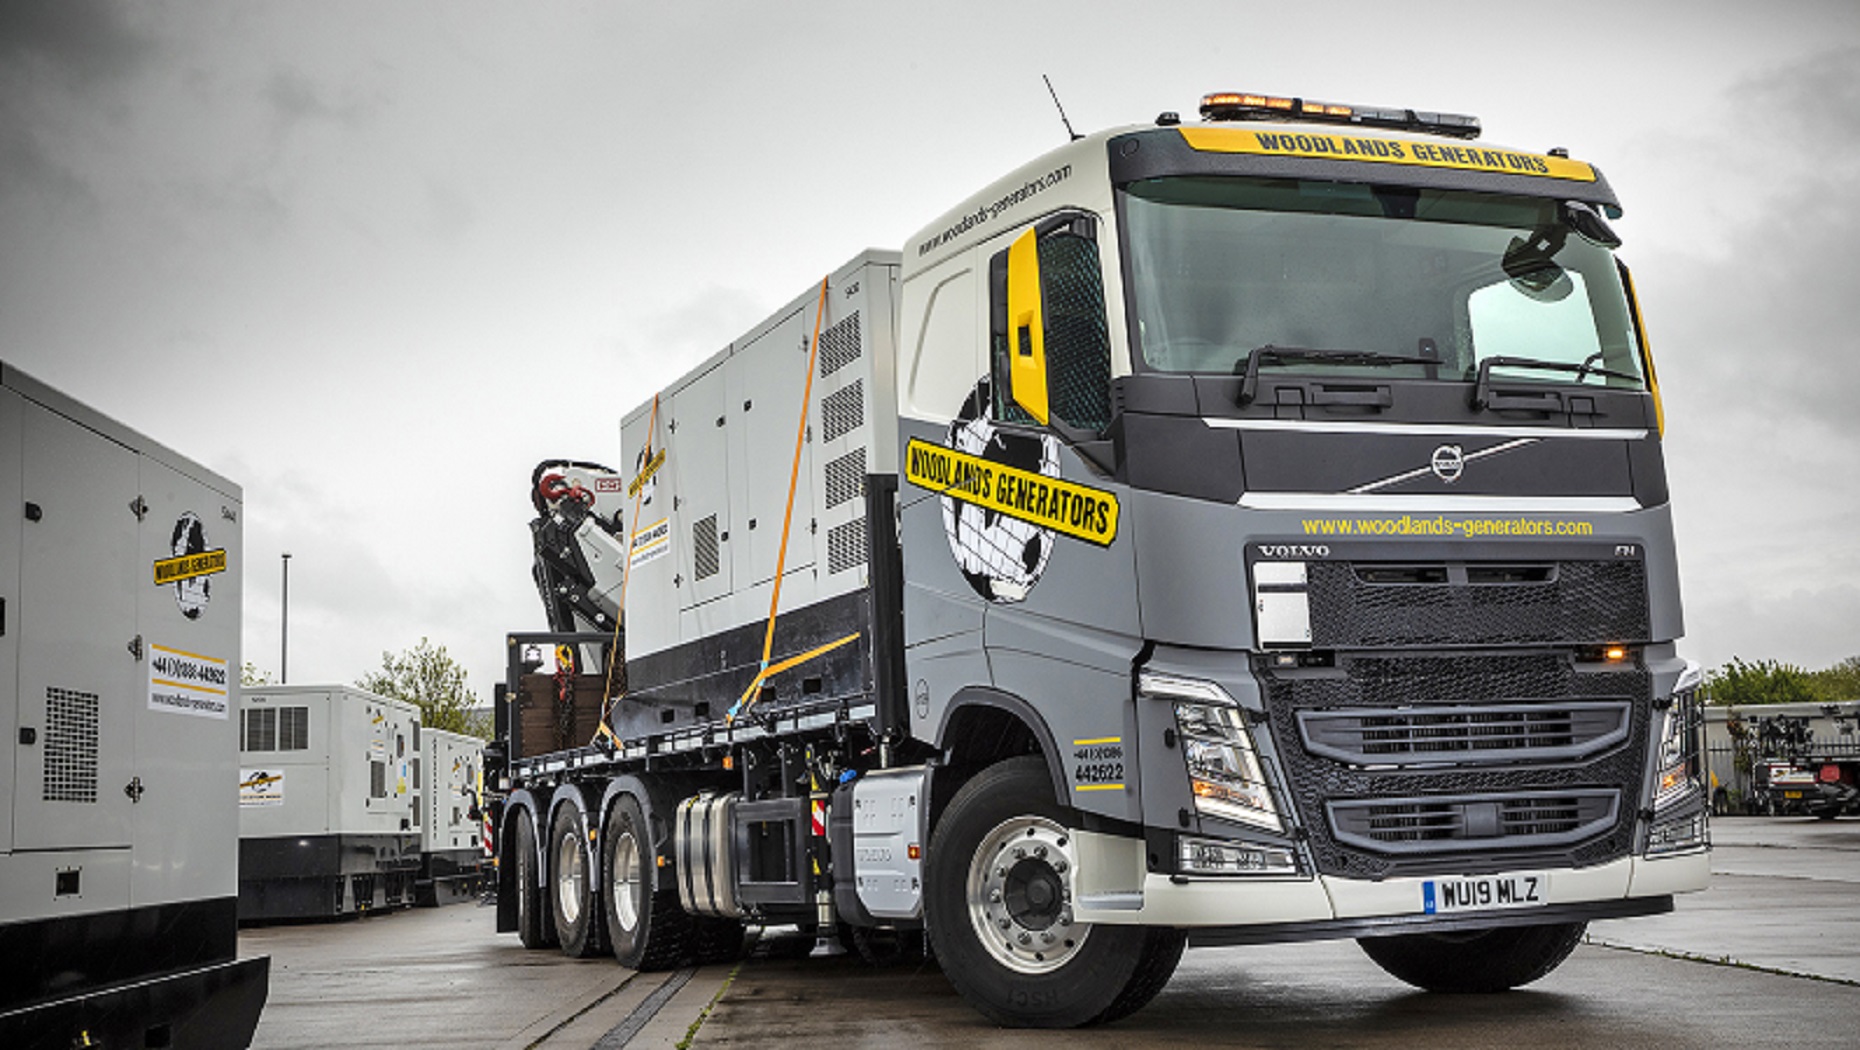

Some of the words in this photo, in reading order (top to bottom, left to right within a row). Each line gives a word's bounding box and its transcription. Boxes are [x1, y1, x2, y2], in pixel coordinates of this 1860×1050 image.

[1254, 132, 1406, 160] WOODLANDS
[1410, 143, 1549, 174] GENERATORS
[911, 446, 993, 499] WOODLANDS
[996, 472, 1110, 535] GENERATORS
[1301, 514, 1593, 538] www.woodlands-generators.com
[1257, 544, 1331, 557] VOLVO
[1075, 763, 1124, 782] 442622
[1441, 880, 1491, 908] WU19
[1496, 876, 1539, 904] MLZ
